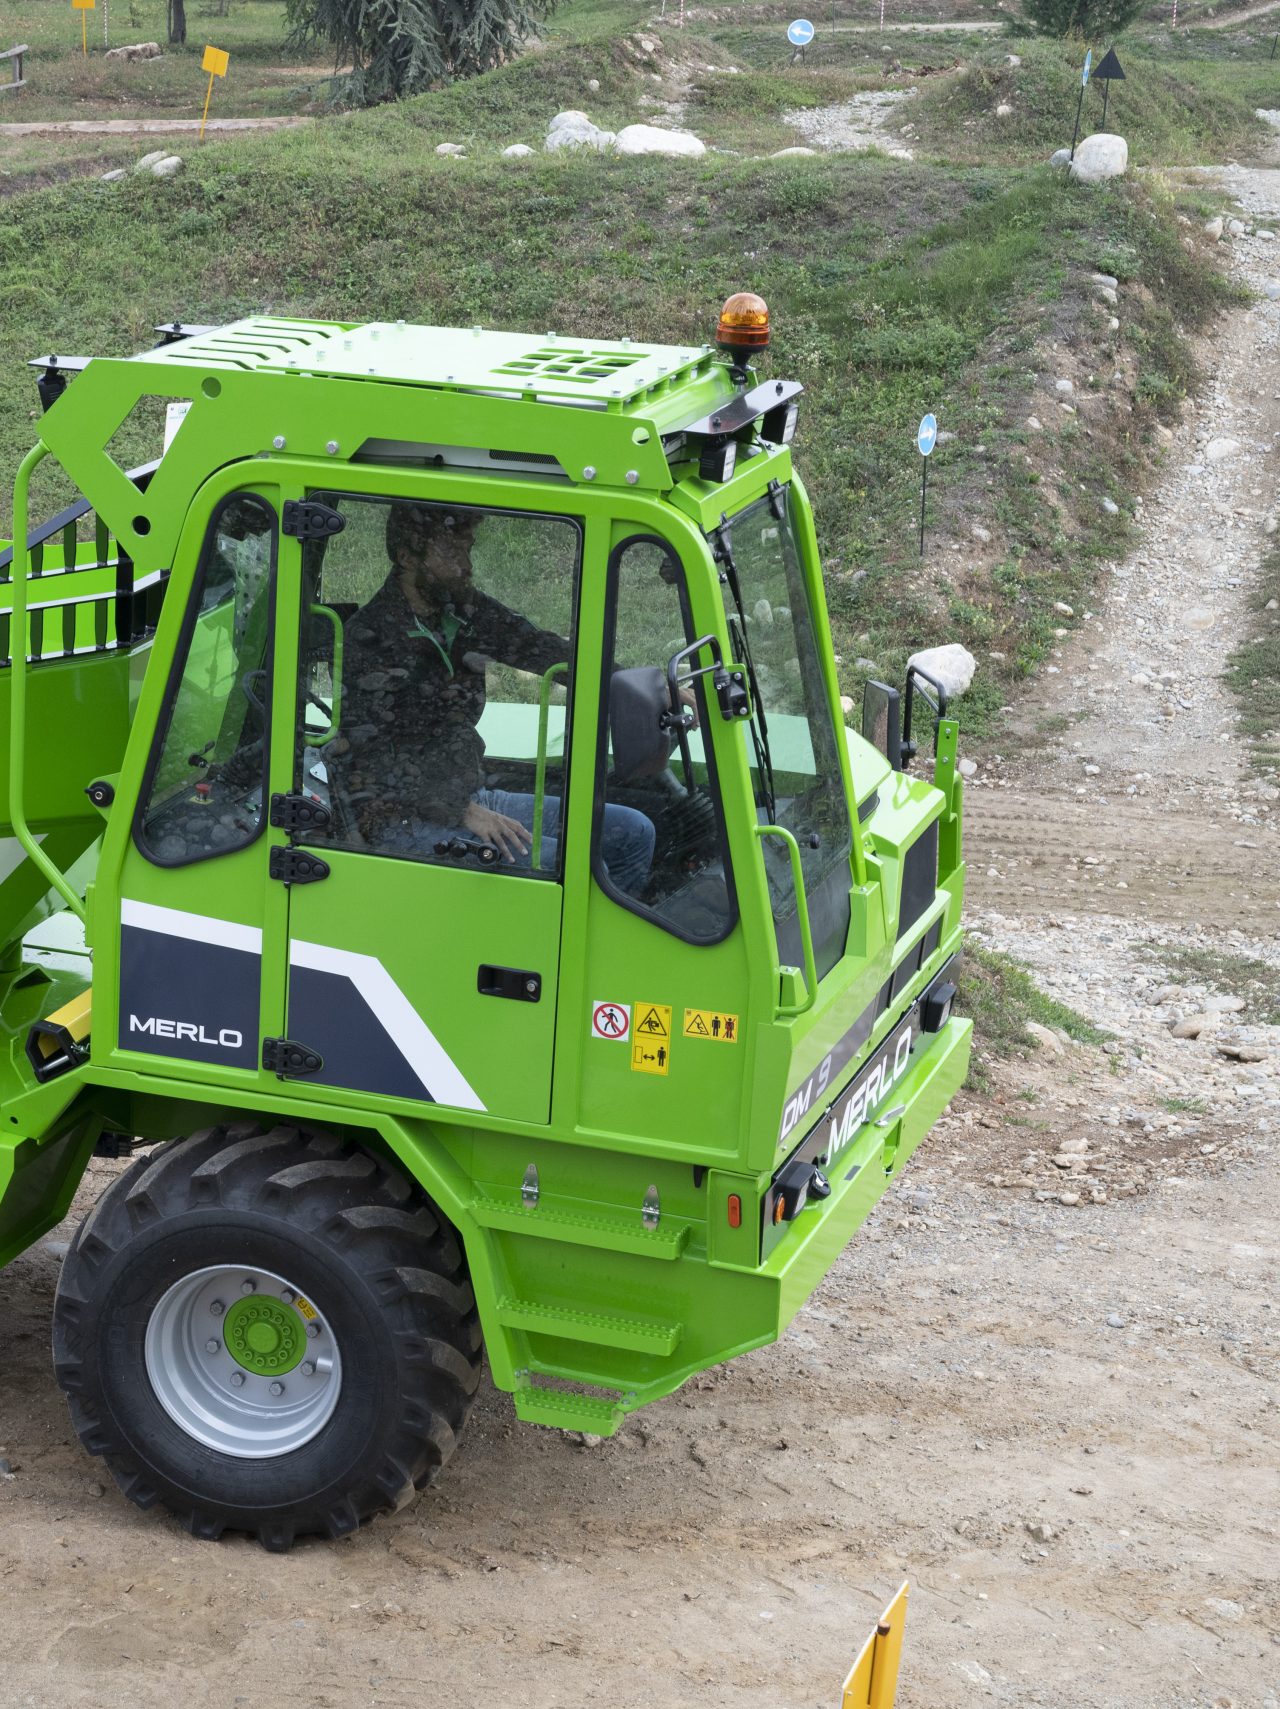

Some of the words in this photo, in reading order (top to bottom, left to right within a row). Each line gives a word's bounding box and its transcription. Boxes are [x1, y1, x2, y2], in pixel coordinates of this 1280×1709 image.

[129, 1014, 243, 1049] MERLO
[781, 1078, 813, 1141] DM
[817, 1053, 832, 1095] 9
[826, 1025, 913, 1167] MERLO
